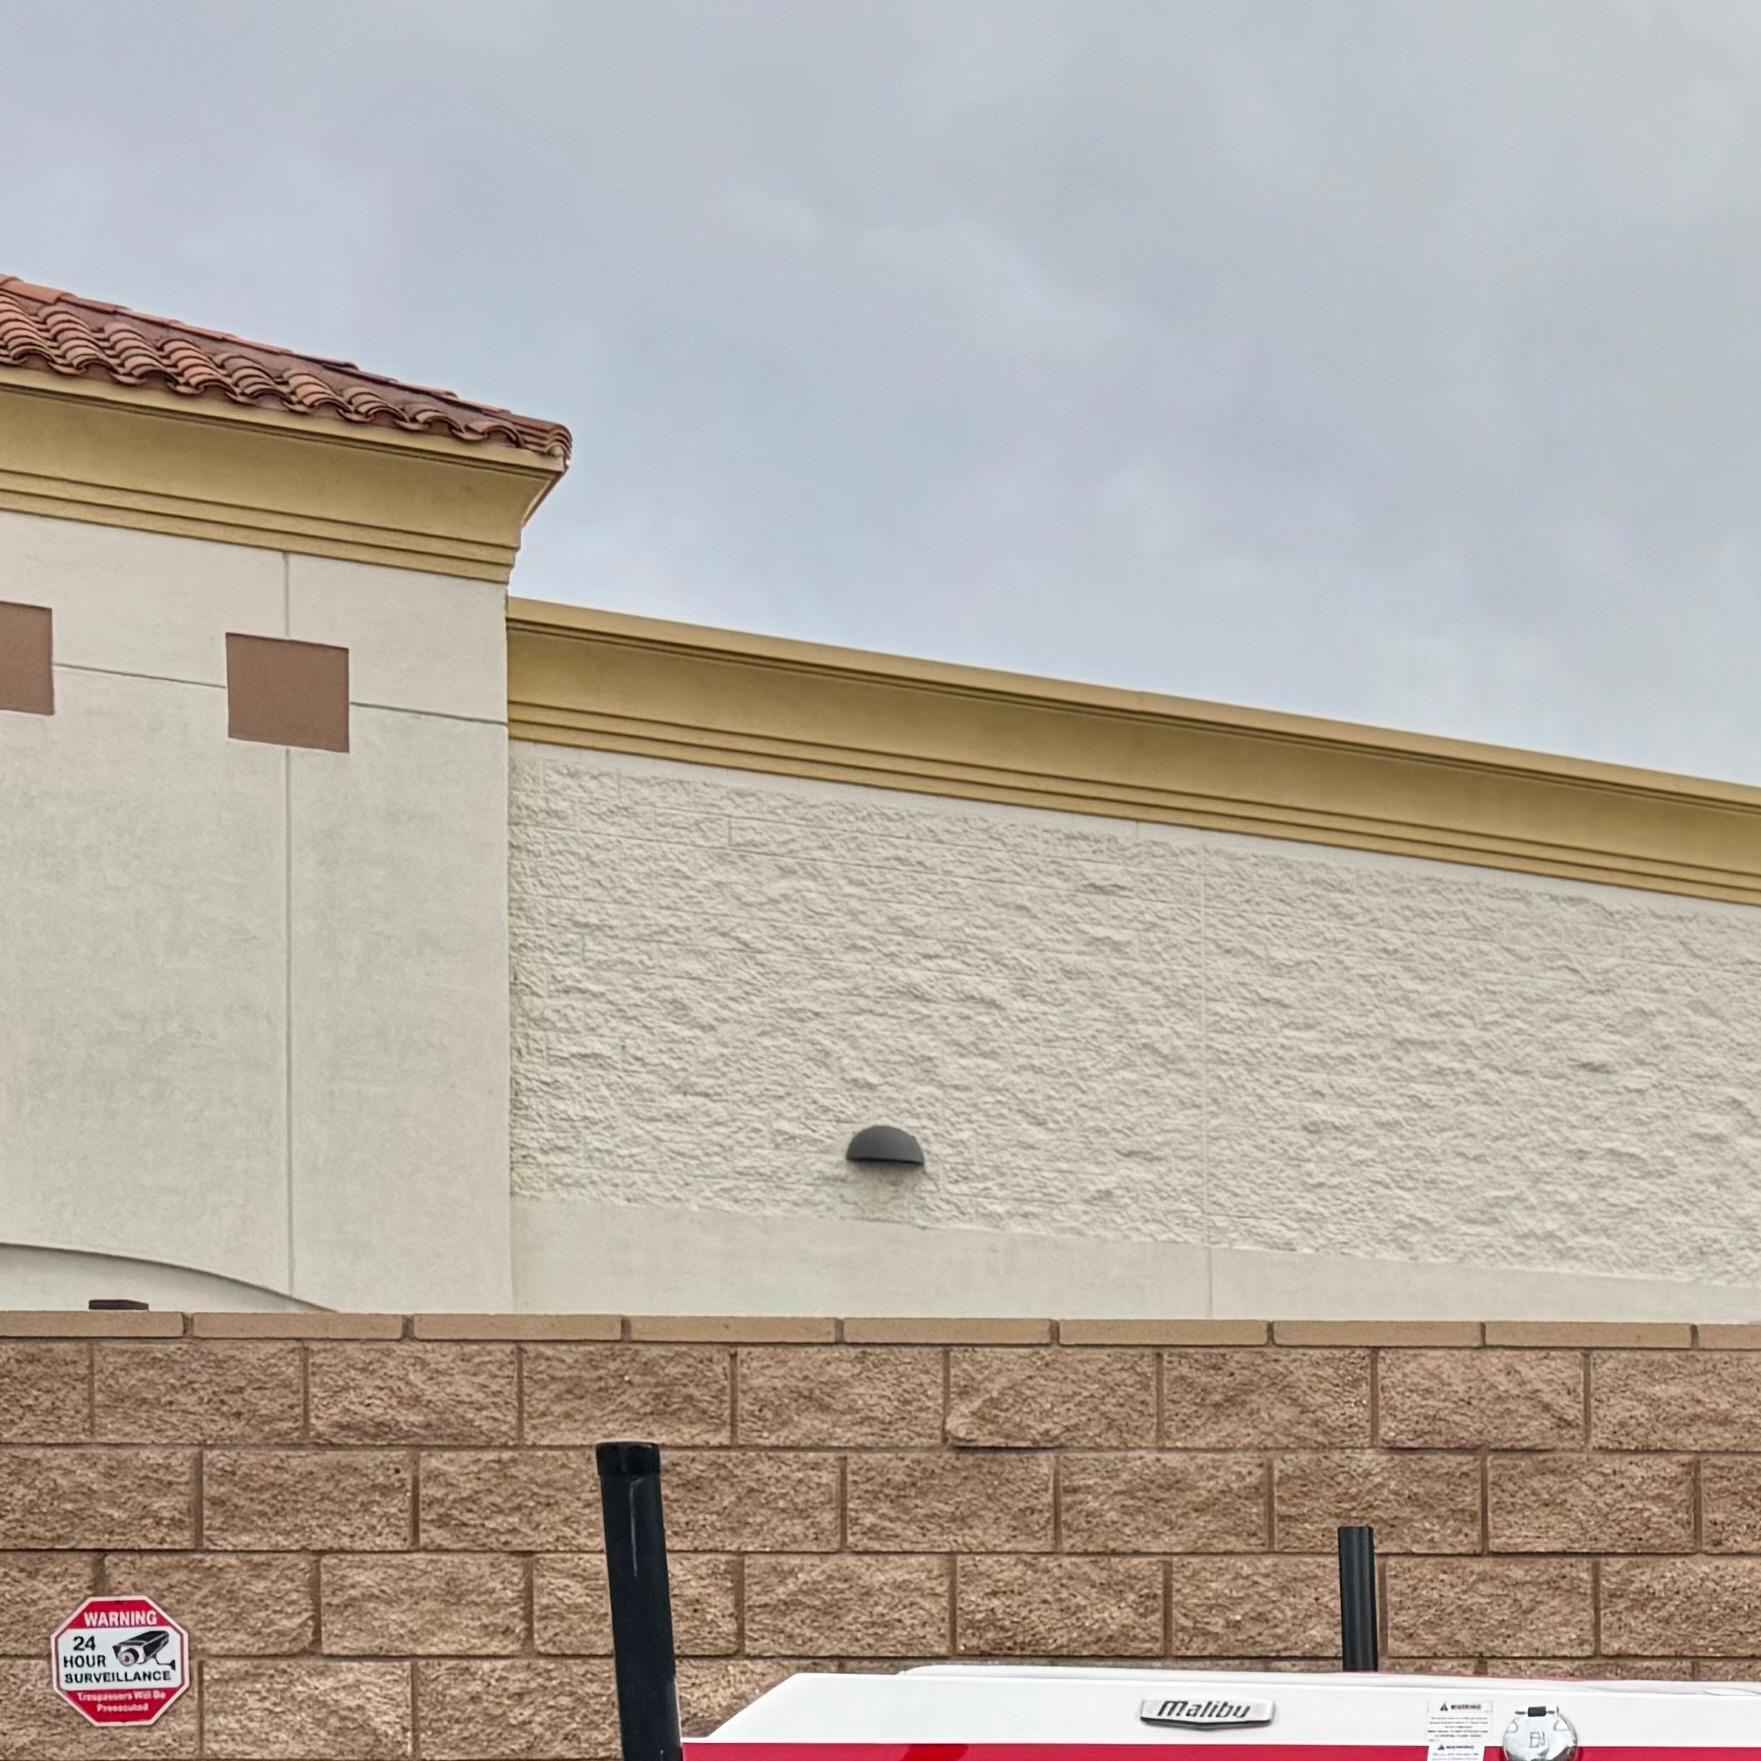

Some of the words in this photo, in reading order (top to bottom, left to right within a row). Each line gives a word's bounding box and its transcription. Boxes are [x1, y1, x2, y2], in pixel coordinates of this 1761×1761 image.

[84, 1610, 157, 1627] WARNING
[73, 1636, 96, 1651] 24
[63, 1655, 106, 1668] HOUR
[64, 1671, 171, 1684] SURVEILLANCE
[1157, 1700, 1251, 1718] Malibu
